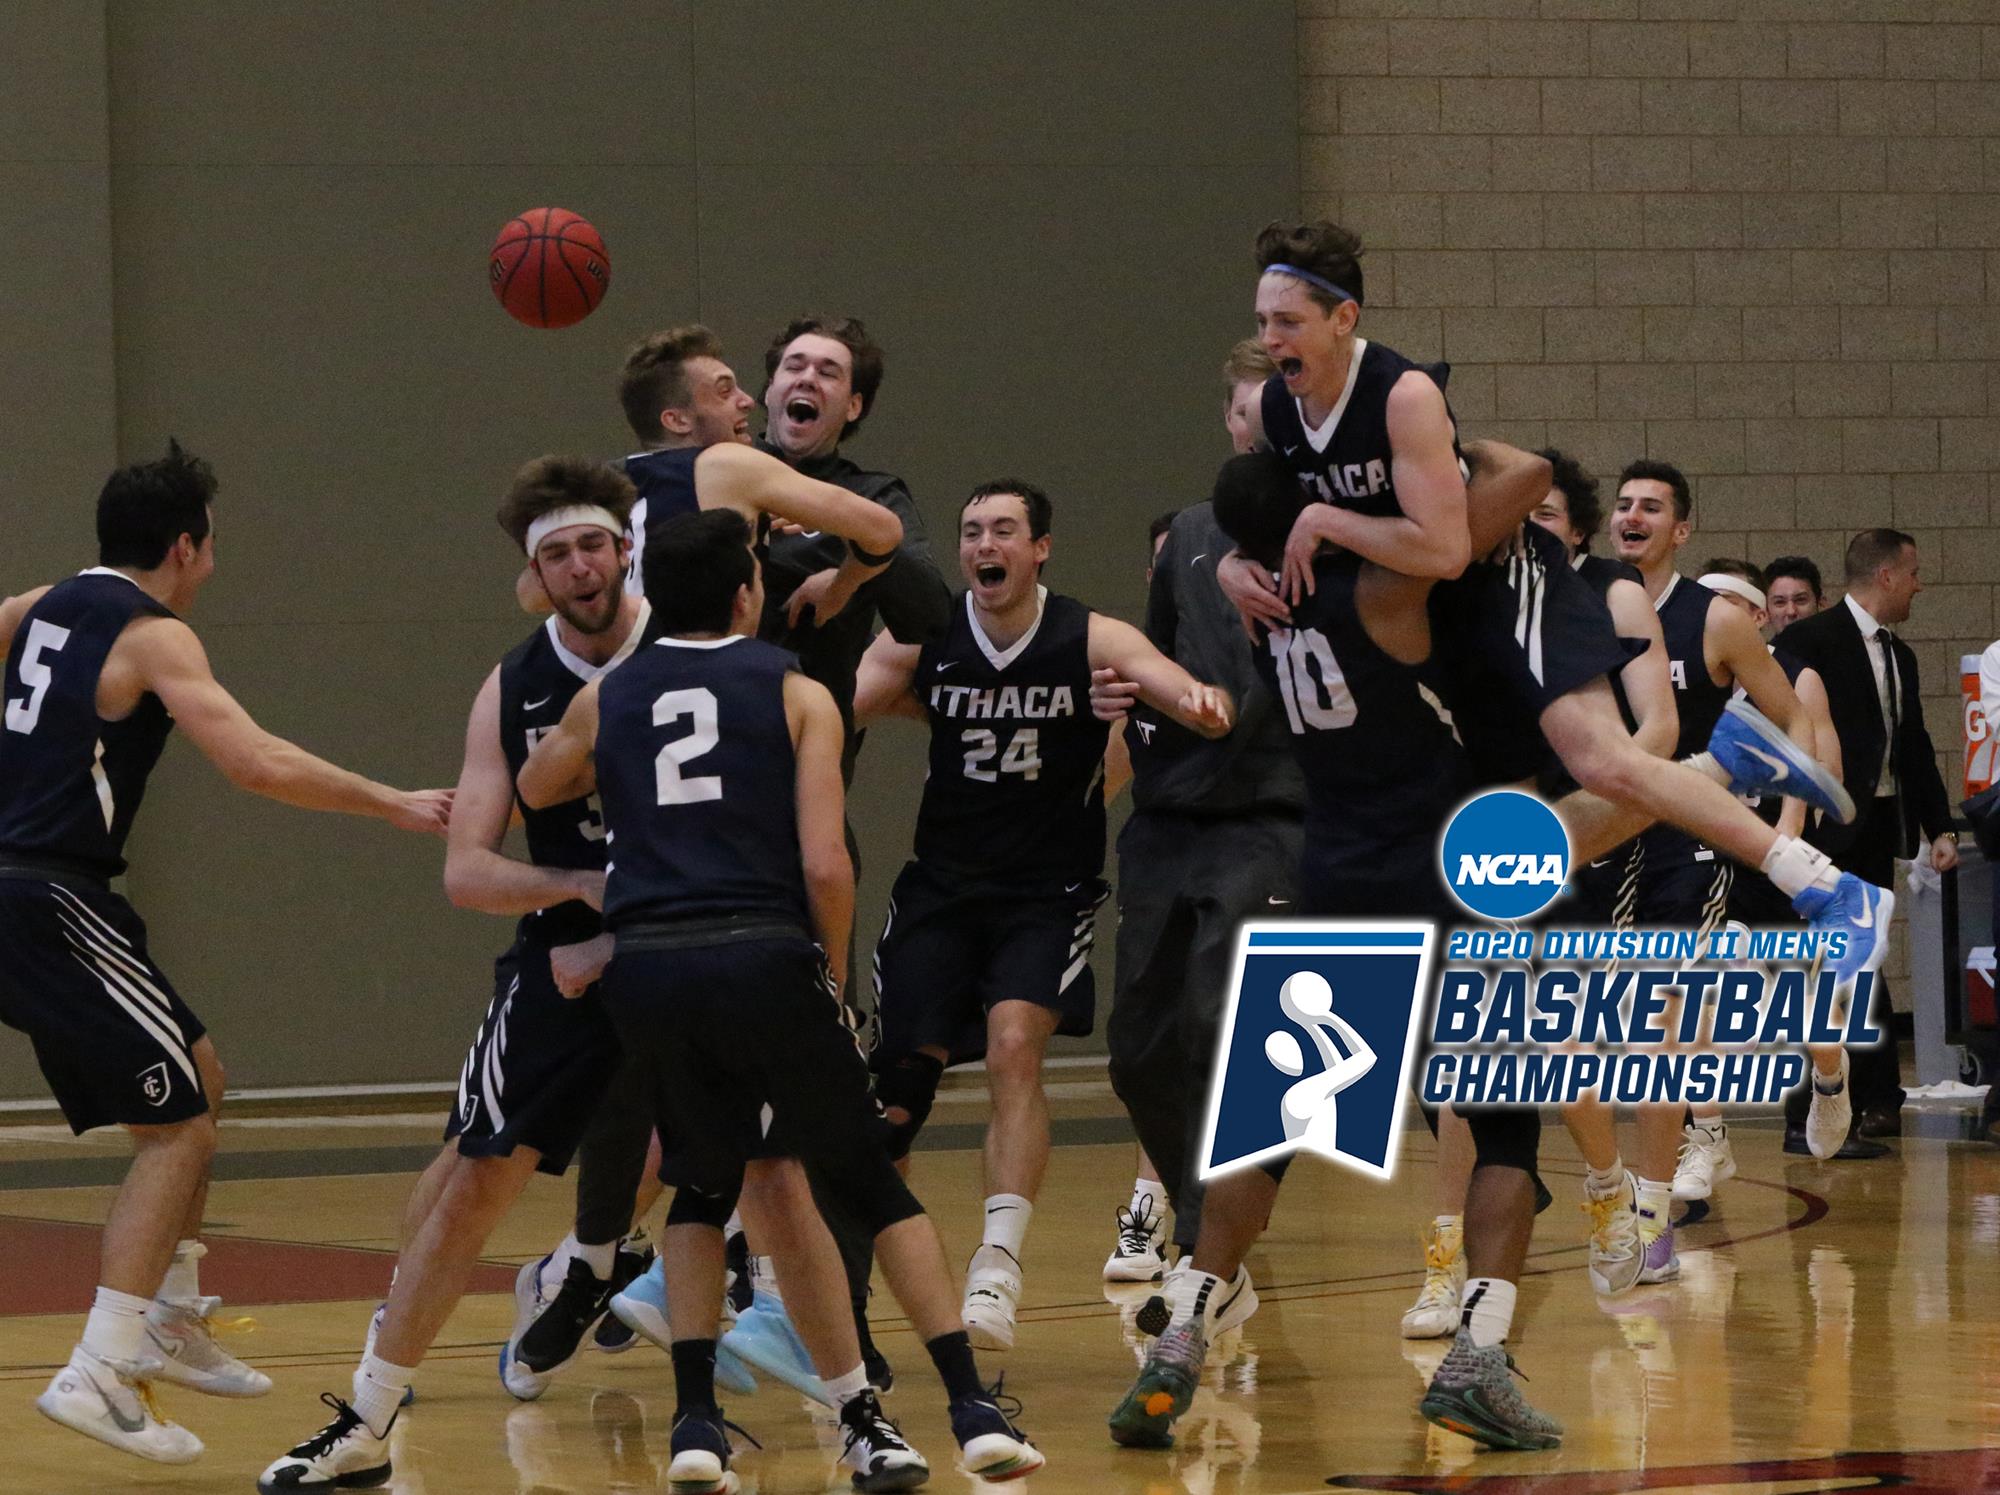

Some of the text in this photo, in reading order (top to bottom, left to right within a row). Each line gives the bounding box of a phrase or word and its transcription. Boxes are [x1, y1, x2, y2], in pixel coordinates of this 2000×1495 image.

[5, 618, 71, 735] 5
[930, 685, 1075, 718] ITHACA
[1267, 627, 1359, 734] 10
[652, 687, 723, 806] 2
[961, 728, 1043, 782] 24
[1965, 700, 1987, 742] G
